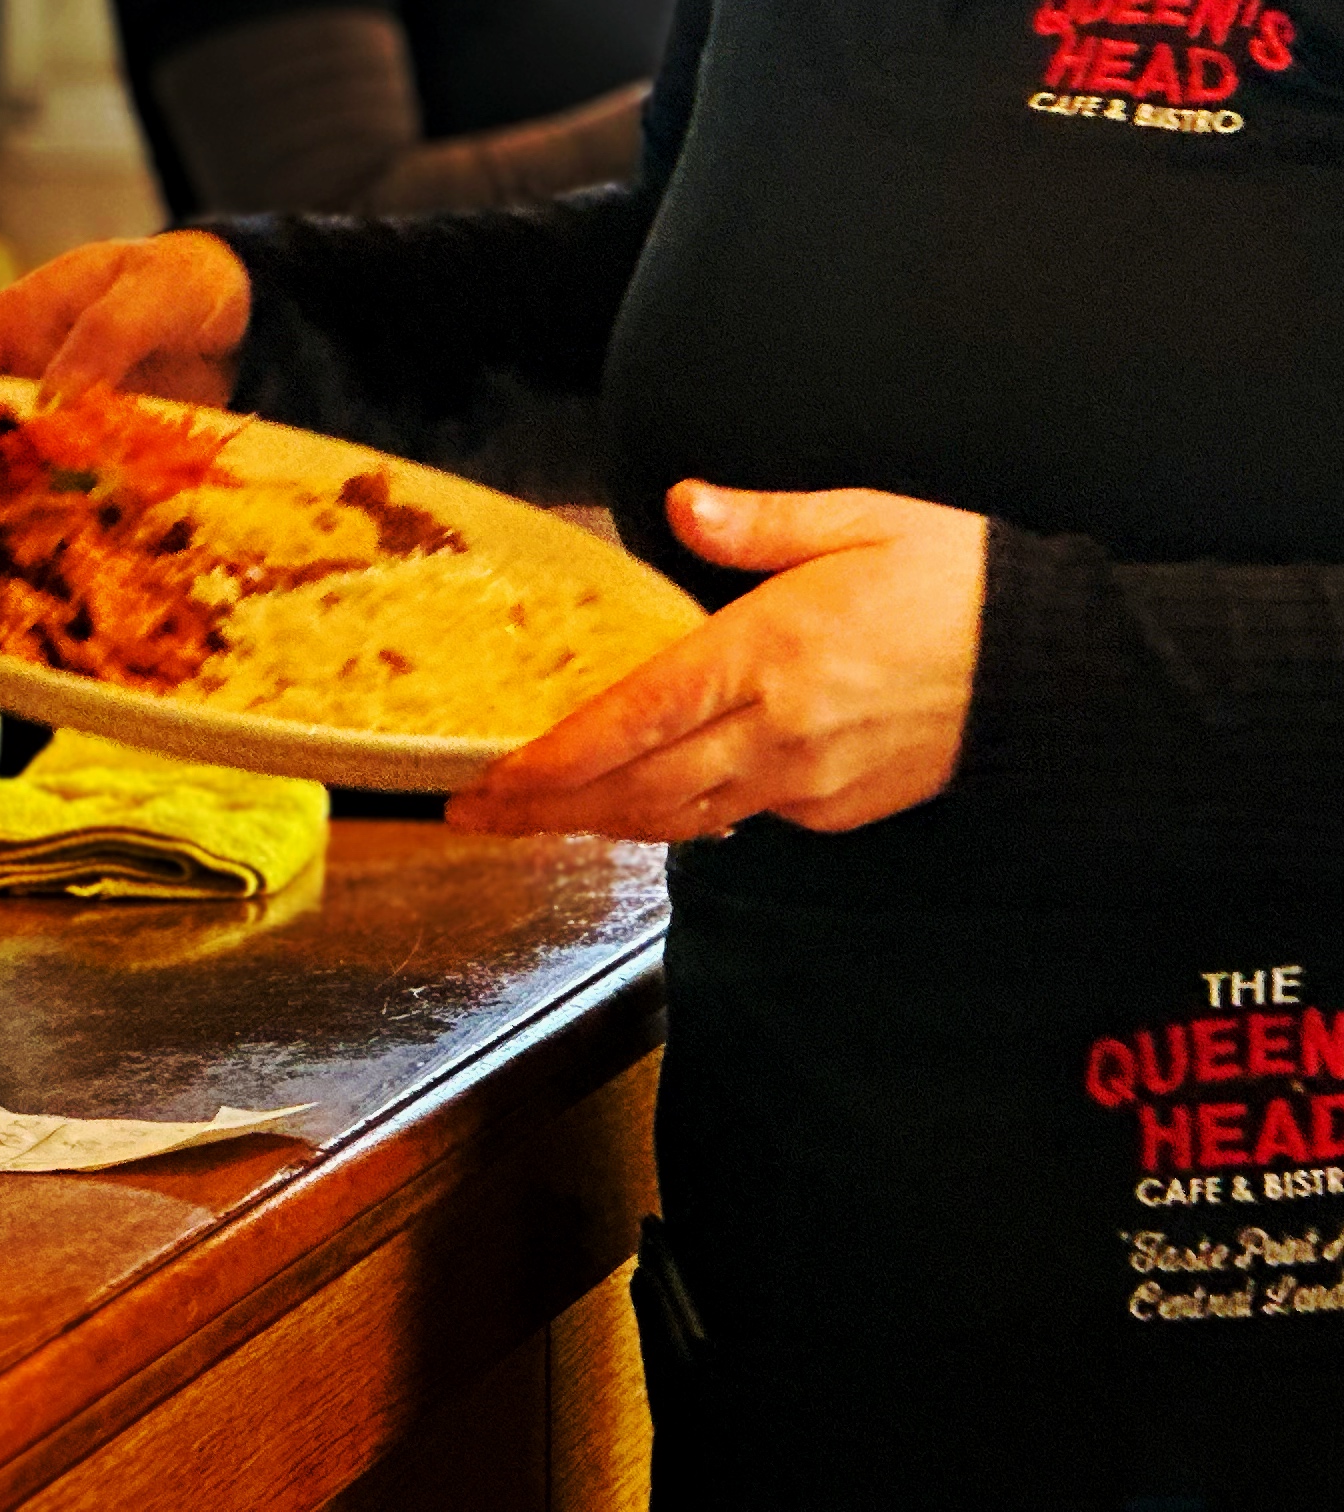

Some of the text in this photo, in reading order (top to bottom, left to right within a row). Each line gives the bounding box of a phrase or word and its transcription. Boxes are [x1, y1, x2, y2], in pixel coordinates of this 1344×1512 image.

[1043, 33, 1240, 105] HEAD
[1132, 102, 1245, 135] BISTRO
[1201, 964, 1305, 1009] THE
[1135, 1176, 1222, 1208] CAFE
[1231, 1175, 1256, 1203] &
